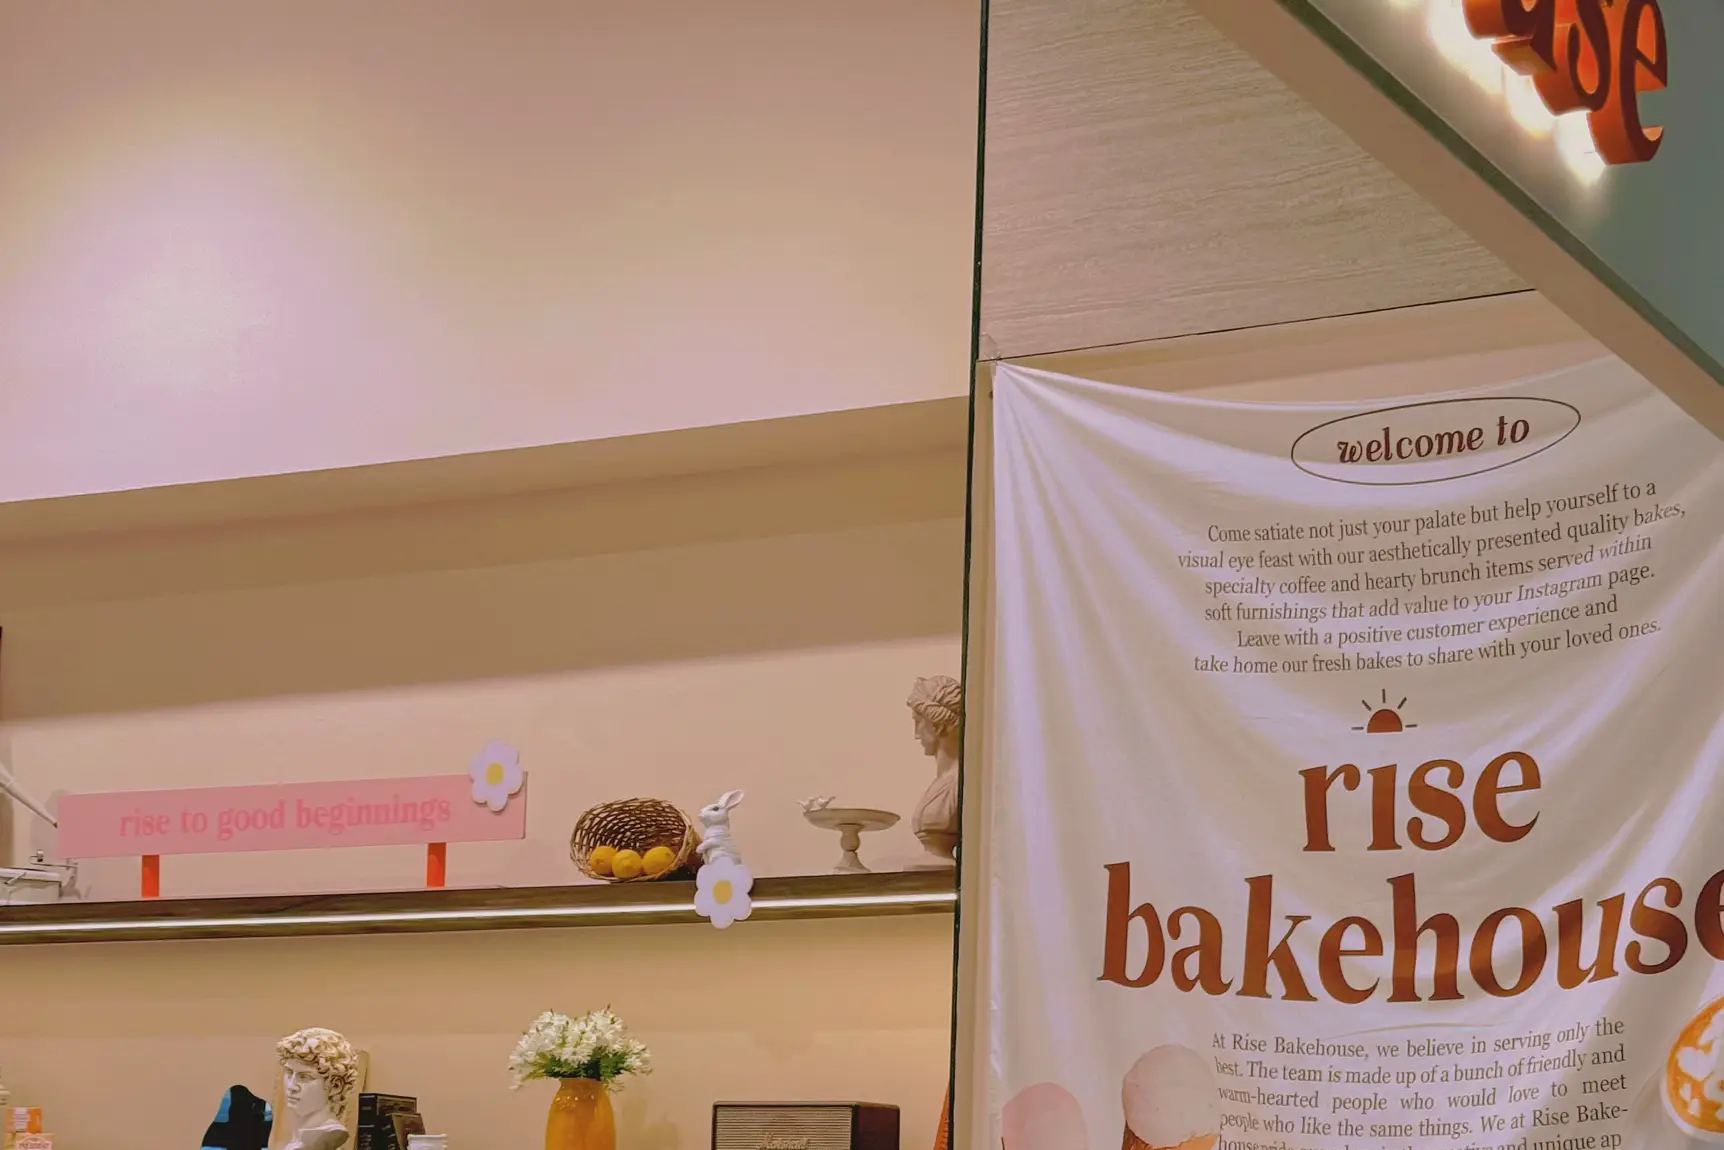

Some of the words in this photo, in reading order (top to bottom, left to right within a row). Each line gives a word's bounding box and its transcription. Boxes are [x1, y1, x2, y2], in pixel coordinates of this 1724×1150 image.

[1337, 426, 1484, 464] welcome
[1496, 416, 1530, 446] to
[1178, 550, 1224, 568] visual
[1228, 556, 1254, 572] eye
[1259, 550, 1294, 568] feast
[1298, 548, 1333, 566] with
[1337, 550, 1364, 564] our
[1369, 535, 1471, 562] aesthetically
[1476, 522, 1562, 556] presented
[1567, 514, 1629, 543] quality
[1633, 503, 1685, 526] bakes,
[1208, 525, 1250, 542] Come
[1254, 523, 1304, 541] satiate
[1309, 522, 1334, 538] not
[1338, 519, 1368, 542] just
[1373, 519, 1410, 539] your
[1414, 510, 1466, 536] palate
[1470, 505, 1498, 524] but
[1504, 498, 1541, 522] help
[1546, 483, 1619, 517] yourself
[1622, 484, 1640, 500] to
[1646, 483, 1656, 496] a
[1205, 577, 1275, 598] specialty
[1280, 576, 1326, 594] coffee
[1331, 573, 1360, 592] and
[1364, 572, 1416, 592] hearty
[1420, 562, 1481, 586] brunch
[1486, 560, 1534, 578] items
[1538, 544, 1594, 571] served
[1600, 535, 1652, 559] within
[1205, 602, 1232, 621] soft
[1236, 602, 1327, 623] furnishings
[1332, 601, 1364, 618] that
[1369, 598, 1399, 616] add
[1404, 595, 1448, 614] value
[1454, 595, 1469, 610] to
[1473, 591, 1512, 612] your
[1516, 574, 1602, 601] Instagram
[1608, 566, 1655, 590] page.
[1237, 630, 1280, 647] Leave
[1284, 628, 1318, 645] with
[1324, 632, 1332, 644] a
[1338, 626, 1402, 648] positive
[1407, 621, 1485, 640] customer
[1488, 605, 1580, 637] experience
[1585, 594, 1618, 616] and
[1194, 655, 1228, 672] take
[1233, 656, 1278, 673] home
[1282, 660, 1308, 672] our
[1312, 653, 1352, 672] fresh
[1357, 651, 1402, 670] bakes
[1407, 652, 1423, 666] to
[1428, 646, 1474, 665] share
[1478, 638, 1516, 658] with
[1520, 637, 1561, 659] your
[1566, 624, 1613, 648] loved
[1619, 621, 1661, 640] ones.
[120, 809, 170, 837] rise
[180, 807, 207, 833] to
[218, 799, 286, 841] good
[296, 796, 451, 836] beginnings
[1299, 751, 1541, 852] rise
[1212, 1033, 1226, 1049] At
[1232, 1034, 1267, 1052] Rise
[1274, 1036, 1369, 1060] Bakehouse,
[1376, 1045, 1399, 1057] we
[1407, 1038, 1464, 1057] believe
[1471, 1036, 1486, 1054] in
[1494, 1033, 1552, 1052] serving
[1557, 1022, 1590, 1043] only
[1595, 1017, 1624, 1036] the
[1214, 1056, 1243, 1077] best.
[1246, 1060, 1278, 1079] The
[1283, 1065, 1322, 1082] team
[1328, 1065, 1342, 1083] is
[1344, 1066, 1391, 1084] made
[1396, 1072, 1416, 1088] up
[1421, 1064, 1439, 1083] of
[1440, 1070, 1449, 1082] a
[1454, 1060, 1503, 1081] bunch
[1508, 1057, 1526, 1077] of
[1526, 1048, 1587, 1074] friendly
[1592, 1043, 1626, 1065] and
[1218, 1087, 1318, 1108] warm-hearted
[1332, 1092, 1387, 1115] people
[1400, 1092, 1434, 1110] who
[1448, 1088, 1496, 1108] would
[1508, 1085, 1539, 1103] love
[1551, 1082, 1567, 1097] to
[1582, 1074, 1627, 1094] meet
